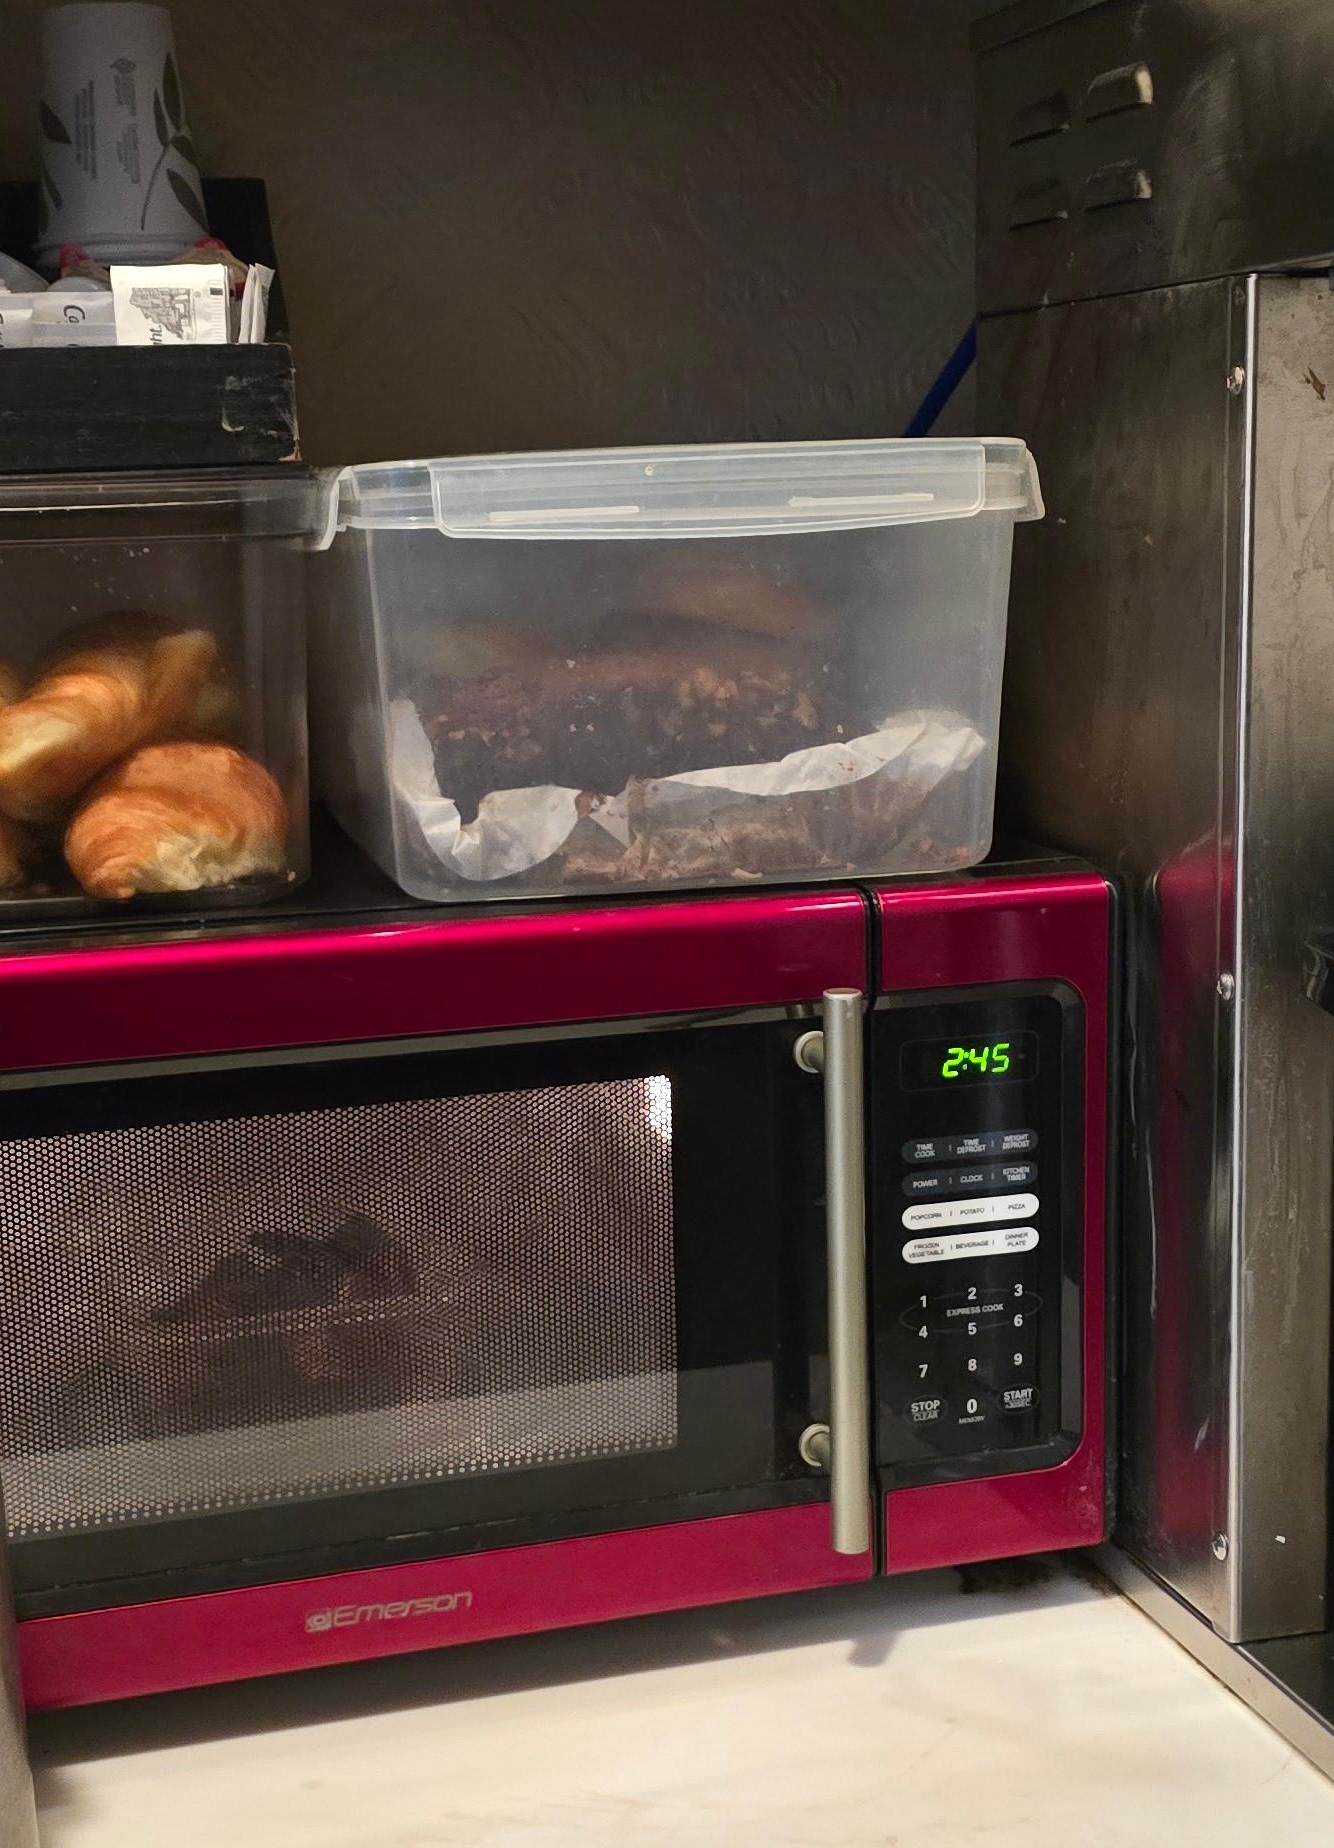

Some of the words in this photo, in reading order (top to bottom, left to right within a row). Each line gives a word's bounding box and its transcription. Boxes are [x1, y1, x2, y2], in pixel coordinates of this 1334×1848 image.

[942, 1043, 1010, 1078] 2:45
[913, 1179, 938, 1188] POWER
[960, 1174, 983, 1183] CLOCK
[910, 1212, 942, 1222] POPCORN
[960, 1207, 985, 1215] POTATO
[1004, 1232, 1028, 1241] DINNER
[1007, 1239, 1026, 1247] PLATE
[913, 1242, 939, 1250] FROZEN
[955, 1240, 989, 1249] BEVERAGE
[908, 1248, 945, 1258] VEGETABLE
[967, 1287, 977, 1300] 2
[1014, 1284, 1023, 1297] 3
[920, 1295, 927, 1308] 1
[946, 1306, 980, 1317] EXPRESS
[982, 1303, 1004, 1313] COOK
[1014, 1314, 1023, 1327] 6
[918, 1325, 928, 1338] 4
[968, 1322, 977, 1335] 5
[968, 1358, 977, 1371] 8
[1014, 1353, 1023, 1365] 9
[919, 1364, 928, 1378] 7
[1003, 1388, 1033, 1400] START
[911, 1400, 940, 1413] STOP
[967, 1398, 977, 1413] 0
[913, 1411, 938, 1421] CLEAR
[333, 1591, 472, 1627] Emerson
